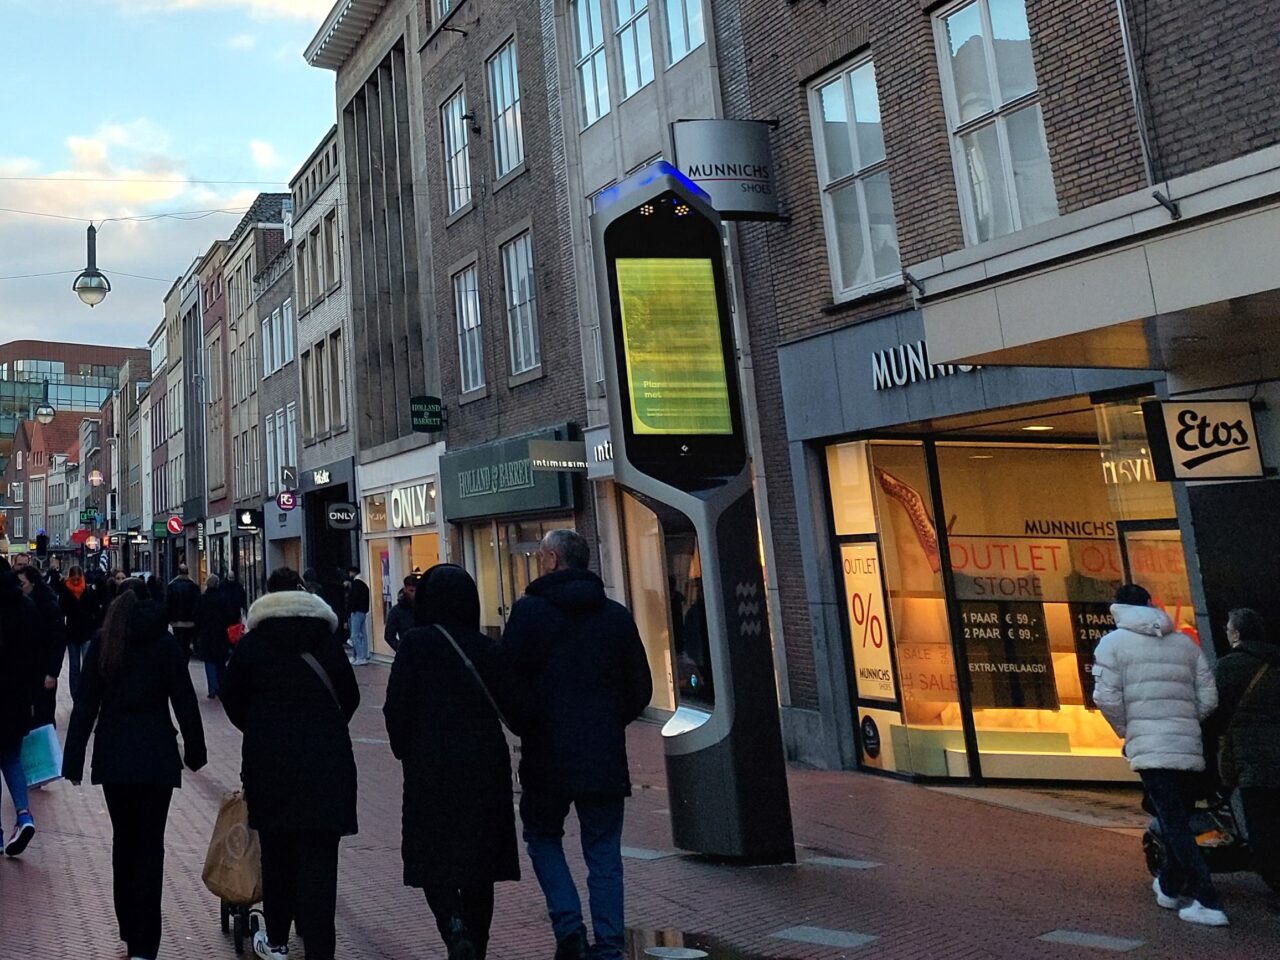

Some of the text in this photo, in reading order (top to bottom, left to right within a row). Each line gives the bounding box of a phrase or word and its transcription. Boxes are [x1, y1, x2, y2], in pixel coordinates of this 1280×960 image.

[688, 164, 770, 178] MUNNICHS
[740, 183, 772, 194] SHOES
[1175, 409, 1249, 451] Etos
[458, 466, 490, 497] HOLLAND
[498, 459, 535, 488] BARRETT
[280, 493, 293, 505] RG
[329, 512, 355, 521] ONLY
[1024, 519, 1115, 536] MUNNICHS
[948, 544, 1061, 571] OUTLET
[844, 558, 876, 574] OUTLET
[973, 577, 1043, 596] STORE
[962, 613, 968, 623] 1
[970, 613, 999, 624] PAAR
[1005, 614, 1013, 624] €
[964, 628, 971, 639] 2
[972, 628, 1001, 639] PAAR
[1008, 628, 1015, 639] €
[1081, 629, 1087, 640] 2
[904, 648, 931, 660] SALE
[860, 668, 890, 681] MUNNICHS
[969, 663, 1047, 673] EXTRA VERLAAGD!
[919, 673, 956, 690] SALE
